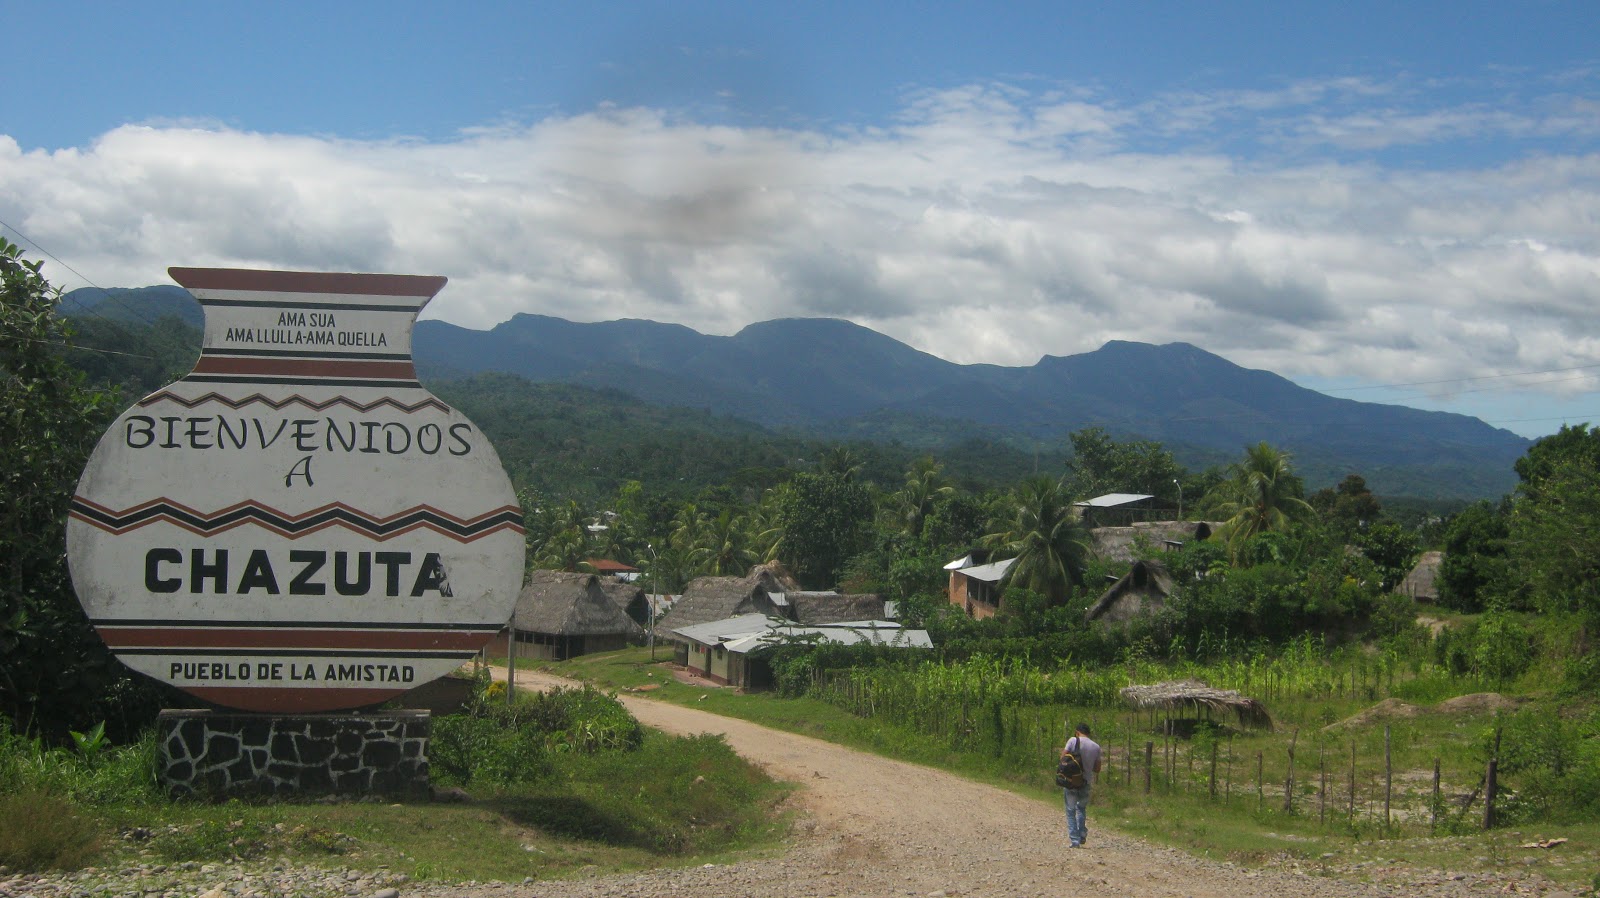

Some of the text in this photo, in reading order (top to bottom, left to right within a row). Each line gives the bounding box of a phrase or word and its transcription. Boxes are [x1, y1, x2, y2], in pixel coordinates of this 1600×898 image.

[277, 312, 336, 328] AMA SUA
[225, 328, 252, 343] AMA
[338, 331, 387, 347] QUELLA
[124, 414, 472, 456] BIENVENIDOS
[284, 455, 314, 487] A
[145, 548, 454, 597] CHAZUTA
[170, 662, 414, 682] PUEBLO DE LA AMISTAD
